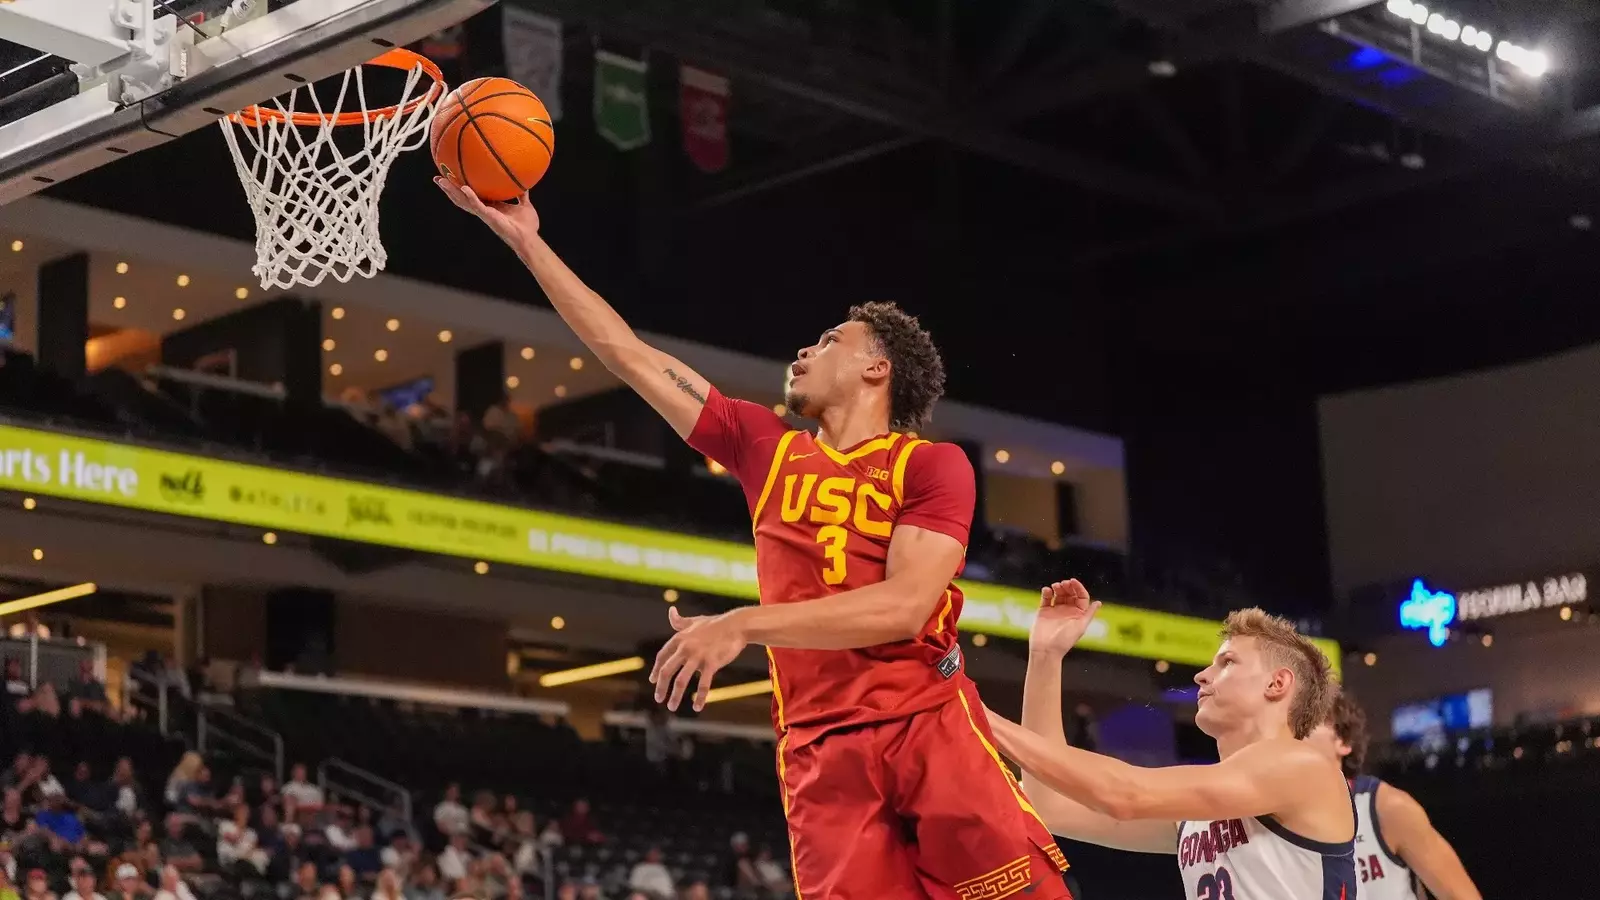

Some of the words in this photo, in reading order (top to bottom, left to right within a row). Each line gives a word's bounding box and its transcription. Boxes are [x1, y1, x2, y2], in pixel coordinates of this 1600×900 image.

[0, 448, 51, 485] rts
[59, 449, 138, 497] Here
[780, 473, 893, 537] USC
[816, 525, 847, 585] 3
